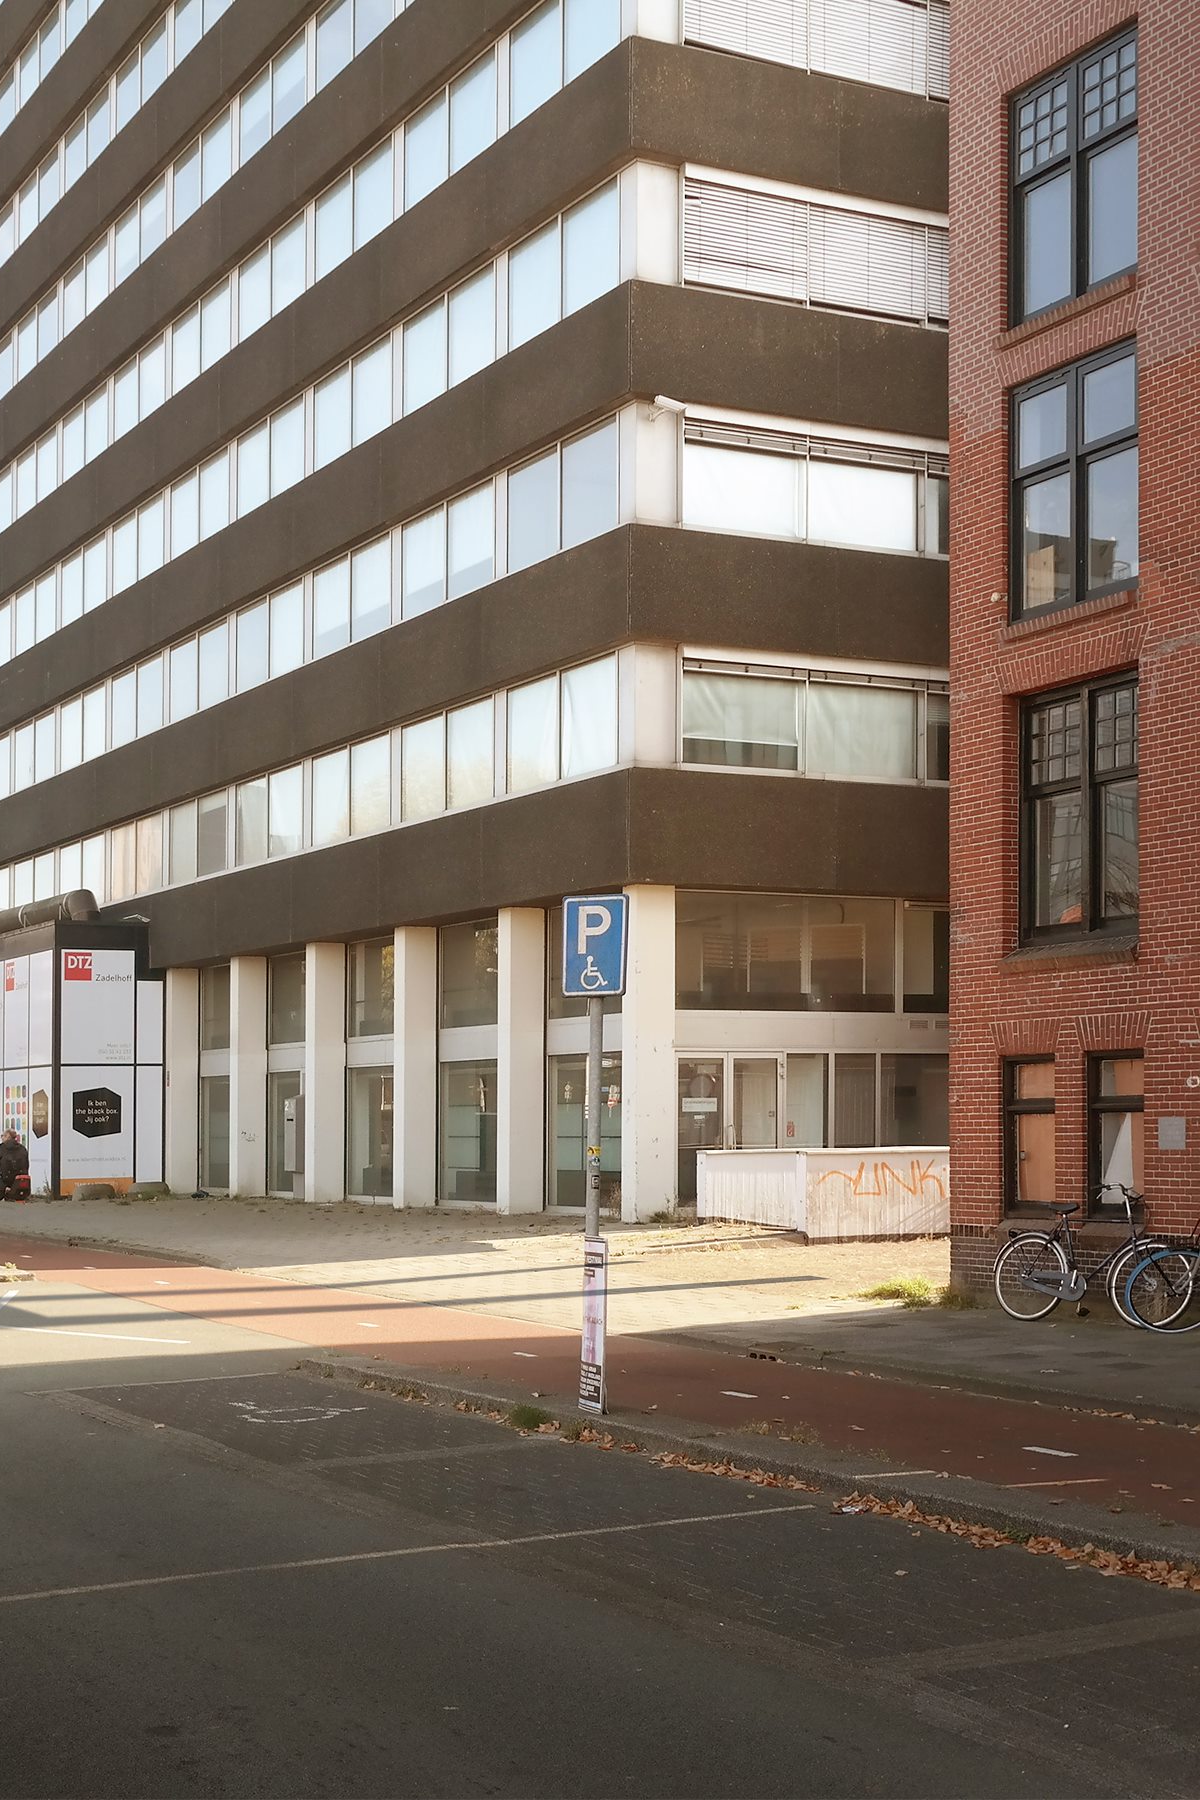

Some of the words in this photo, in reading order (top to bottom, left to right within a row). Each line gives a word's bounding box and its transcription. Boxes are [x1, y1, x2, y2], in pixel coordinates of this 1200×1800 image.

[578, 905, 611, 954] P
[67, 955, 92, 969] DTZ
[95, 973, 132, 982] Zadelhoff
[87, 1107, 104, 1115] black
[94, 1115, 110, 1123] ook?
